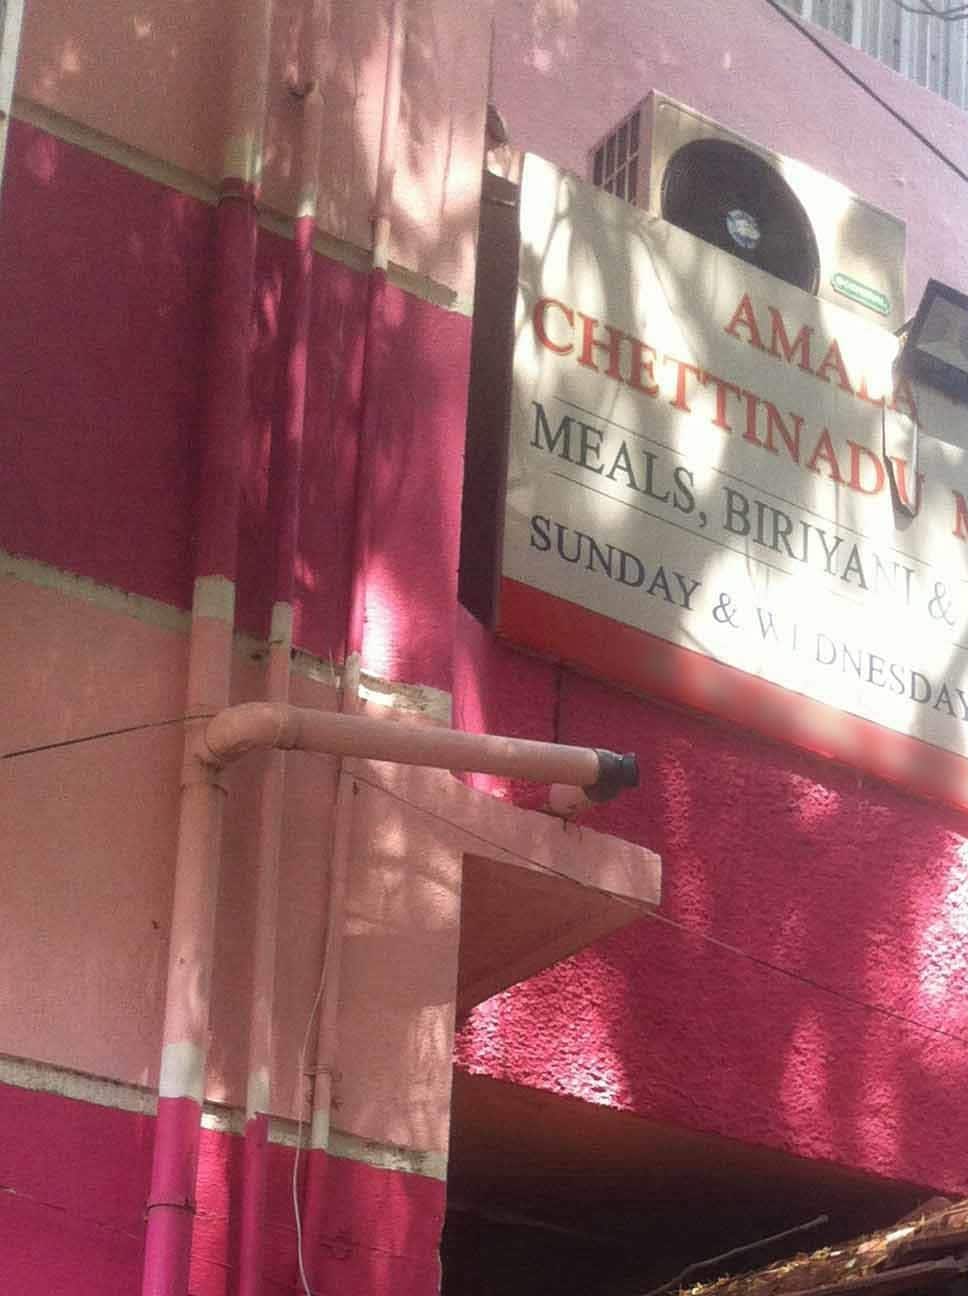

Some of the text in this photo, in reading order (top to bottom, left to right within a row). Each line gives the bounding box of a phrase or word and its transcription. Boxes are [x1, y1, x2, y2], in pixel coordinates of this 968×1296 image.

[532, 297, 925, 512] CHETTINADU
[529, 514, 702, 610] SUNDAY
[712, 592, 740, 628] &
[530, 400, 707, 528] MEALS,
[723, 486, 916, 604] BIRIYANI
[928, 581, 957, 626] &
